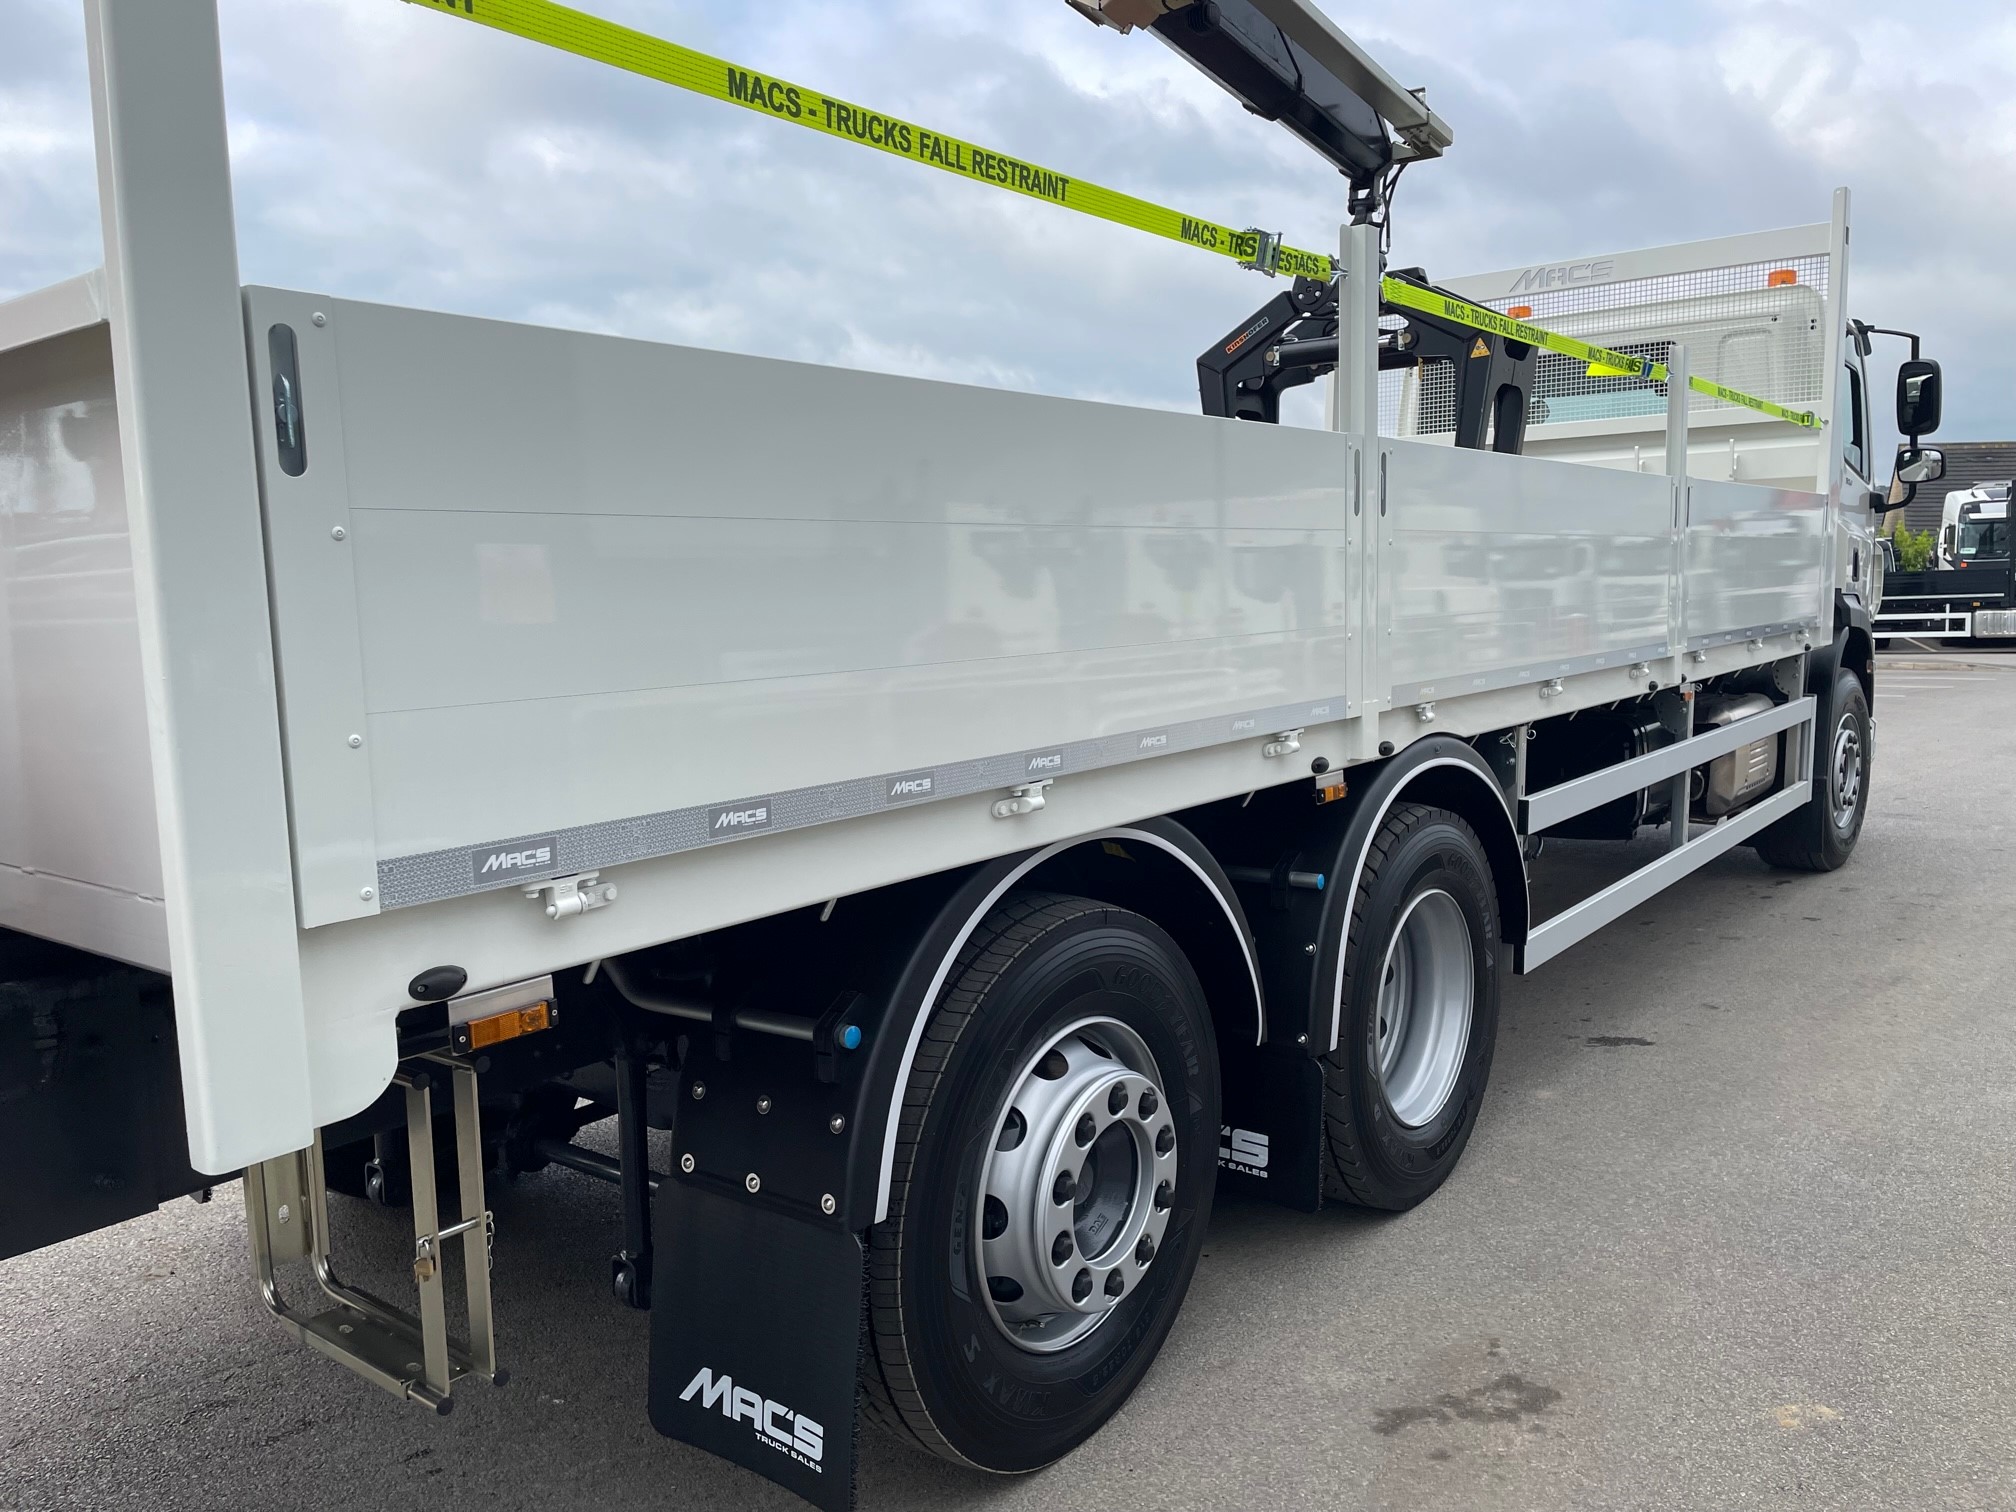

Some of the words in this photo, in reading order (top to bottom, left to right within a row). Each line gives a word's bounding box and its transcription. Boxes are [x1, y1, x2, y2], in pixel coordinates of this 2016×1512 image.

[727, 66, 802, 118] MACS
[821, 98, 912, 153] TRUCKS
[919, 131, 967, 172] FALL
[972, 149, 1070, 202] RESTRAINT
[1181, 217, 1218, 248] MACS
[1226, 317, 1269, 354] KINSHOFER
[1444, 299, 1465, 321] MACS
[1470, 308, 1498, 331] TRUCKS
[1499, 318, 1515, 336] FALL
[1515, 324, 1549, 346] RESTRAINT
[1587, 346, 1603, 362] MACS
[1605, 351, 1625, 369] TRUCKS
[1228, 1162, 1268, 1178] SALES
[755, 1432, 789, 1455] TRUCK
[790, 1450, 823, 1474] SALES
